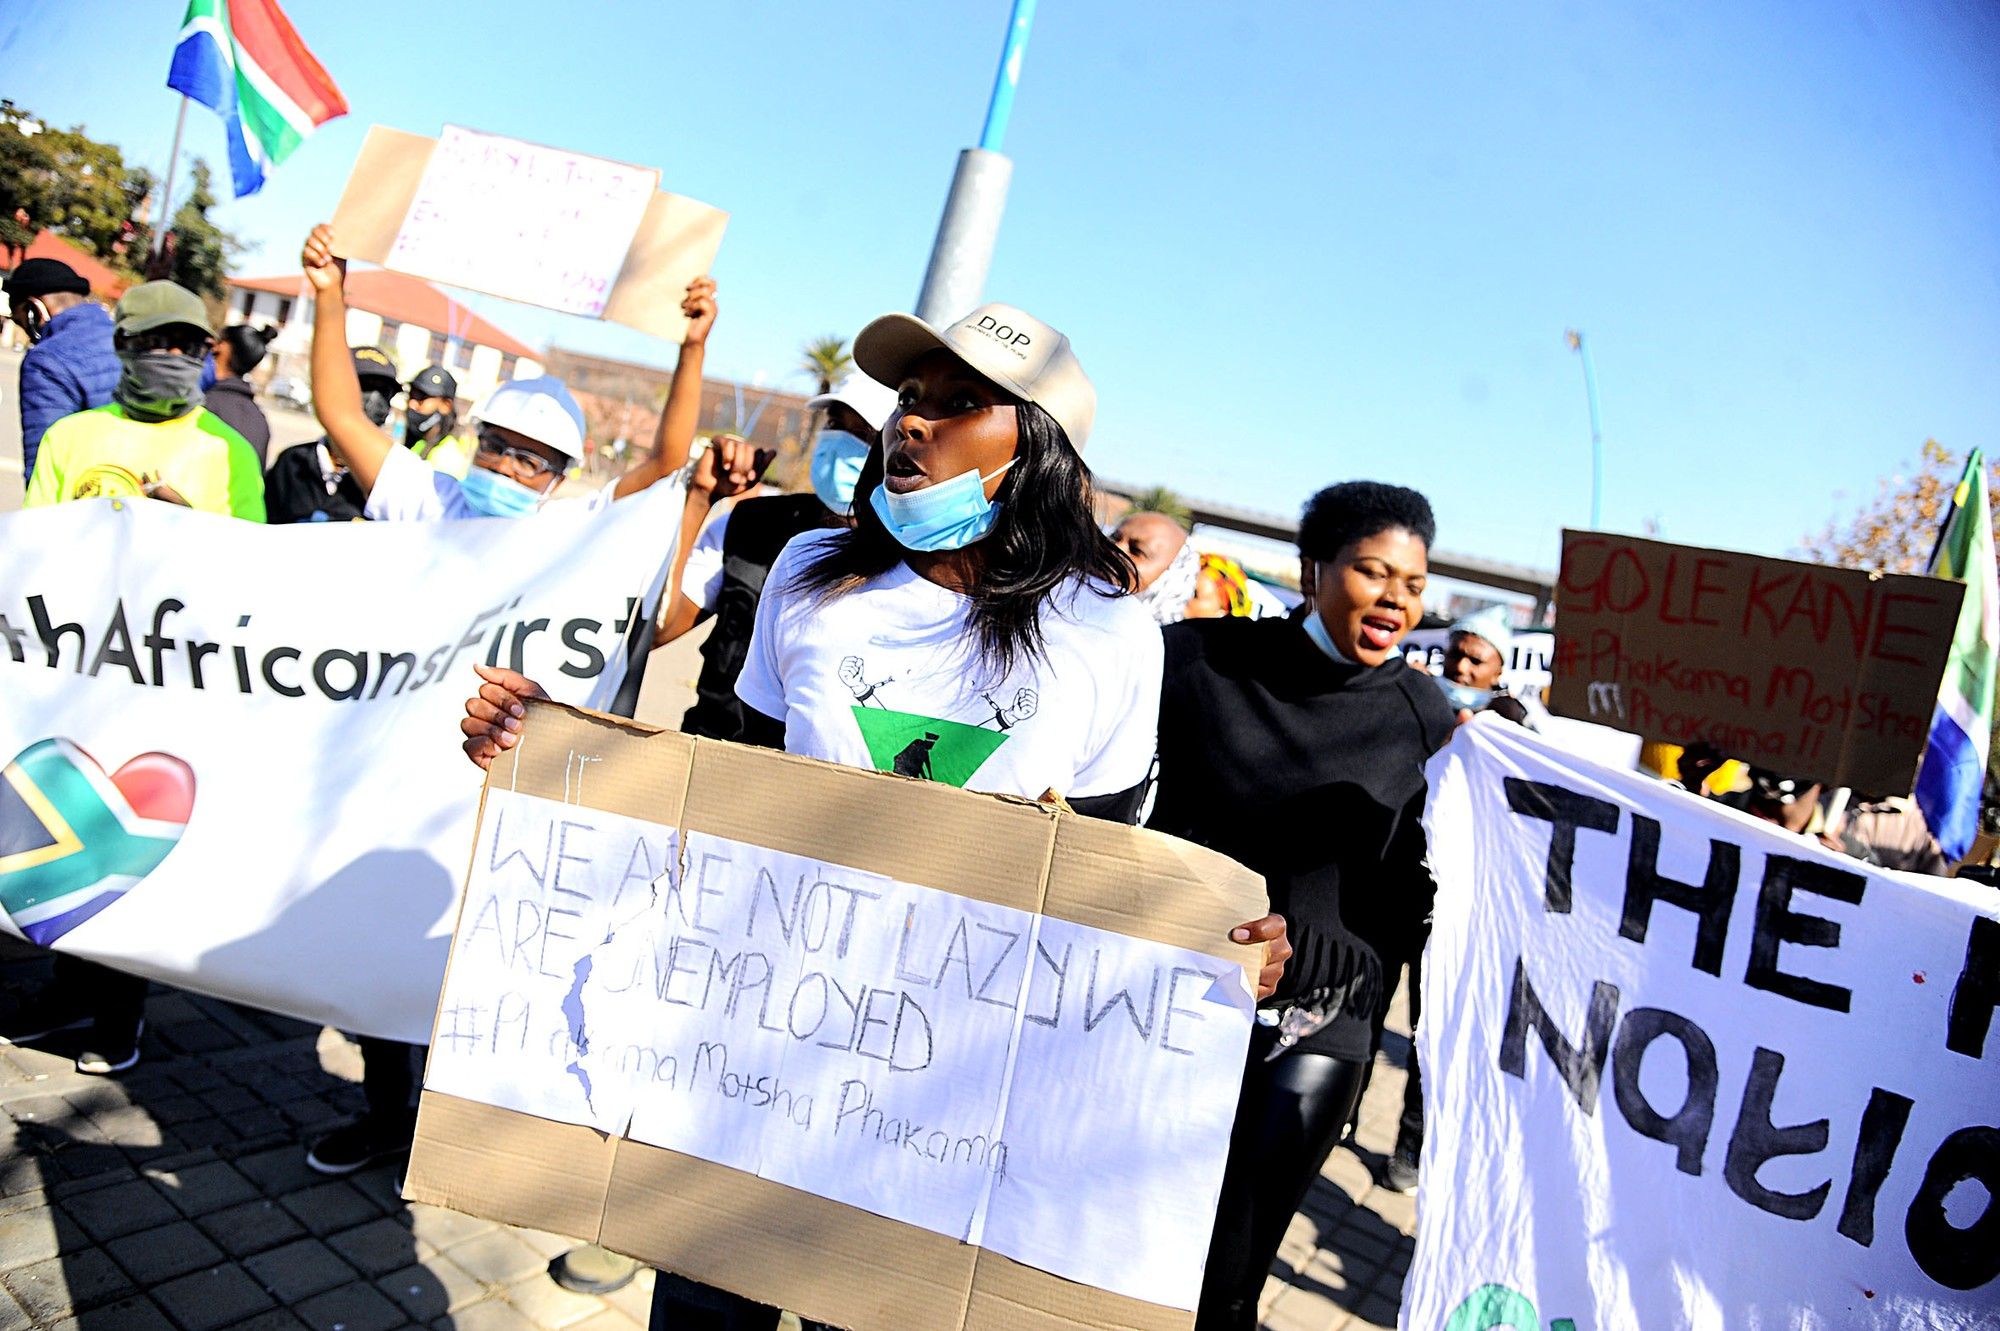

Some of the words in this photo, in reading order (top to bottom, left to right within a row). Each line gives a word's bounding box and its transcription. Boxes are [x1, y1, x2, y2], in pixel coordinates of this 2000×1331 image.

[977, 315, 1031, 345] DOP
[463, 894, 583, 979] ARE
[603, 933, 934, 1073] UNEMPLOYED
[490, 808, 595, 901] WE
[612, 836, 732, 935] ARE
[746, 866, 882, 959] NOT
[894, 902, 1072, 1029] LAZY
[1084, 949, 1218, 1056] WE
[1503, 776, 1868, 1014] THE
[689, 1041, 814, 1131] Motsha
[834, 1079, 1008, 1188] Phakama
